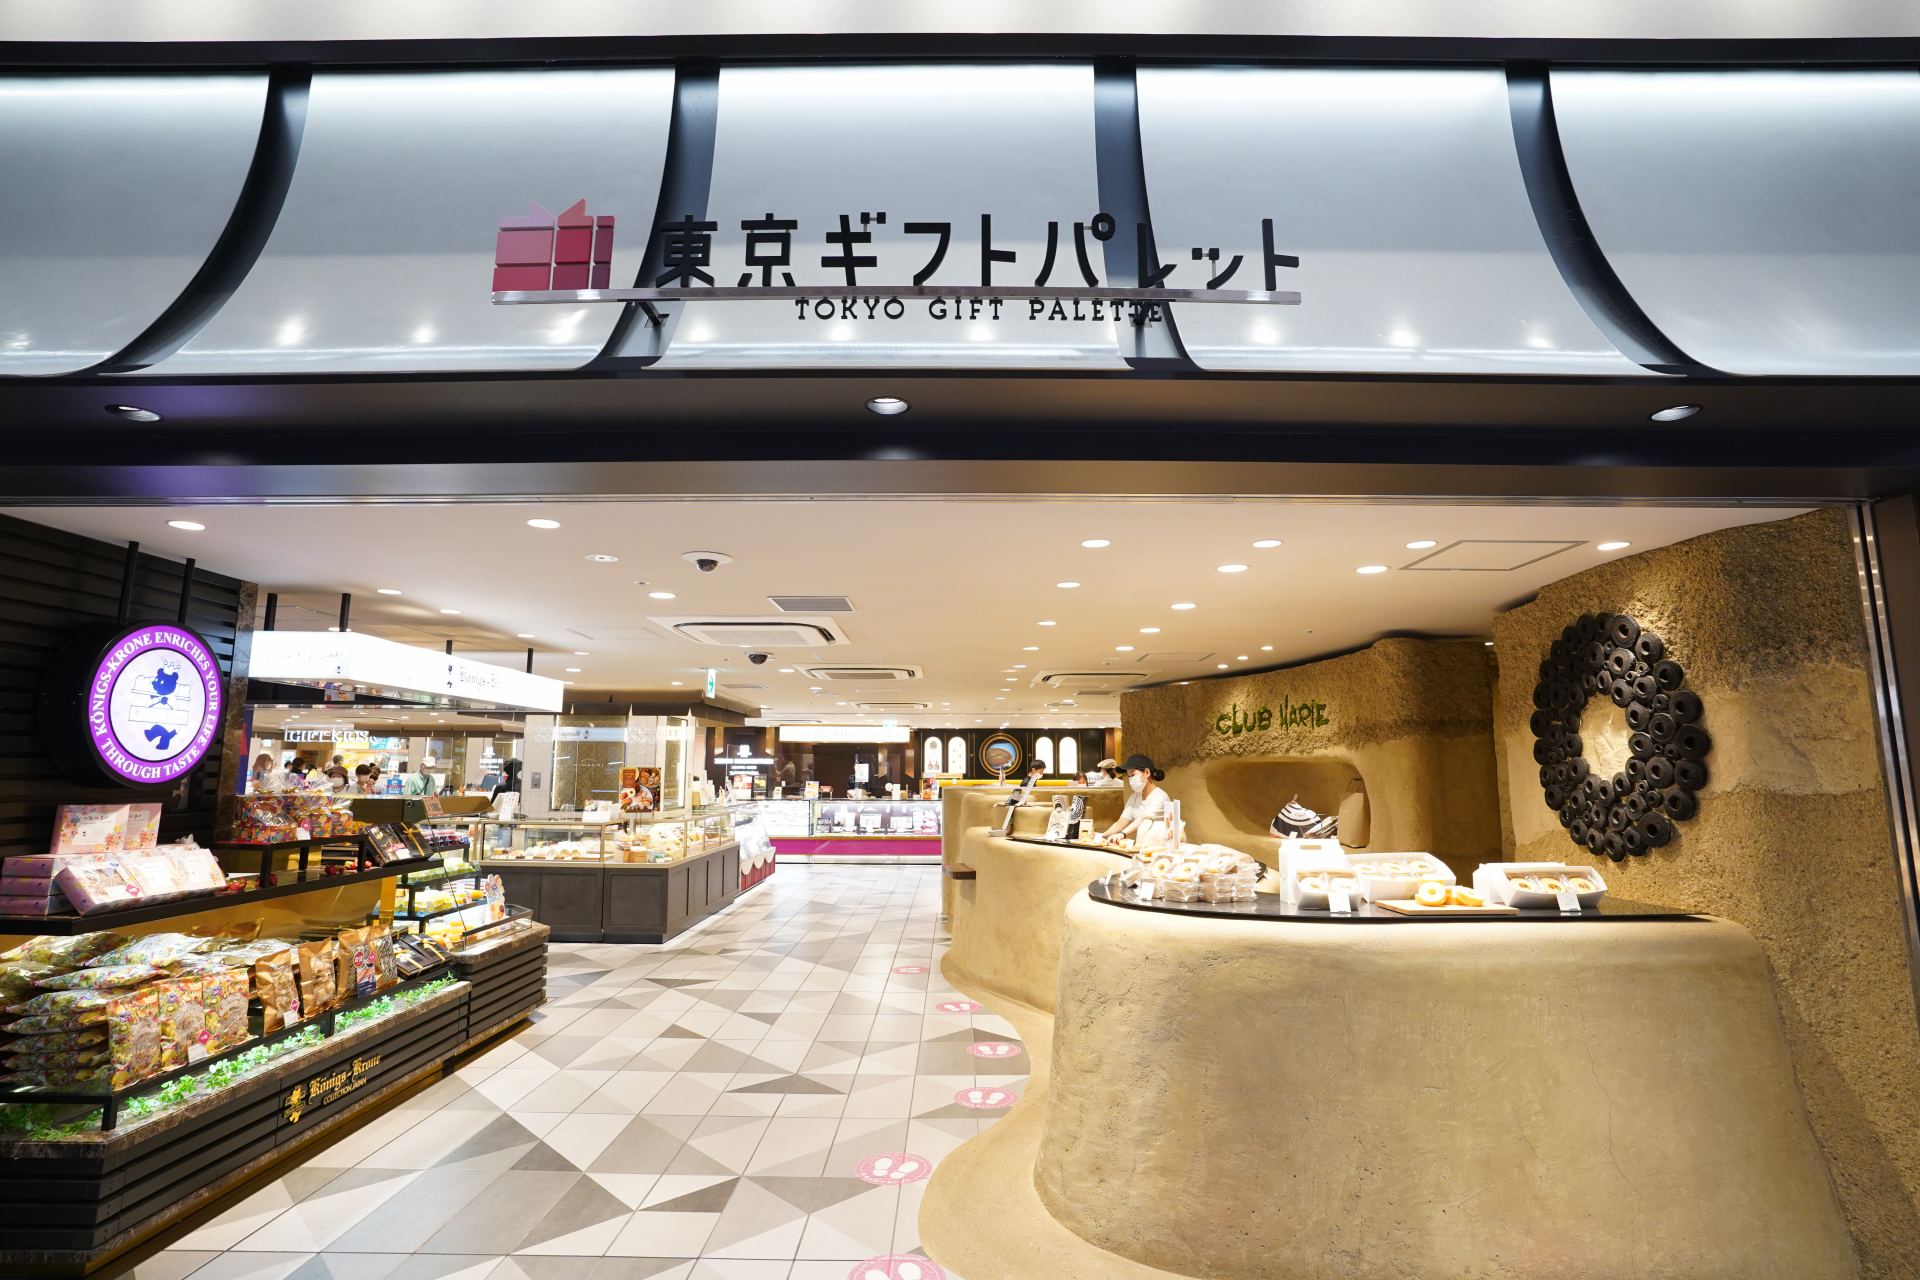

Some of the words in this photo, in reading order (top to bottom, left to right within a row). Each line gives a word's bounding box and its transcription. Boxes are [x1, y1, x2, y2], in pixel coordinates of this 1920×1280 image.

[655, 212, 1300, 291] 東京ギフトパレット
[795, 296, 904, 320] TOKYO
[928, 296, 1003, 320] GIFT
[1029, 297, 1162, 322] PALETTE
[155, 632, 210, 671] ENRICHES
[91, 632, 152, 736] KÖNIGS-KRONE
[205, 670, 218, 711] YOUR
[198, 711, 217, 746] LIFE
[1216, 702, 1272, 735] CLUB
[1280, 694, 1330, 734] HARIE
[101, 737, 161, 778] THROUGH
[163, 745, 200, 777] TASTE
[309, 1056, 381, 1105] Königs-Krone
